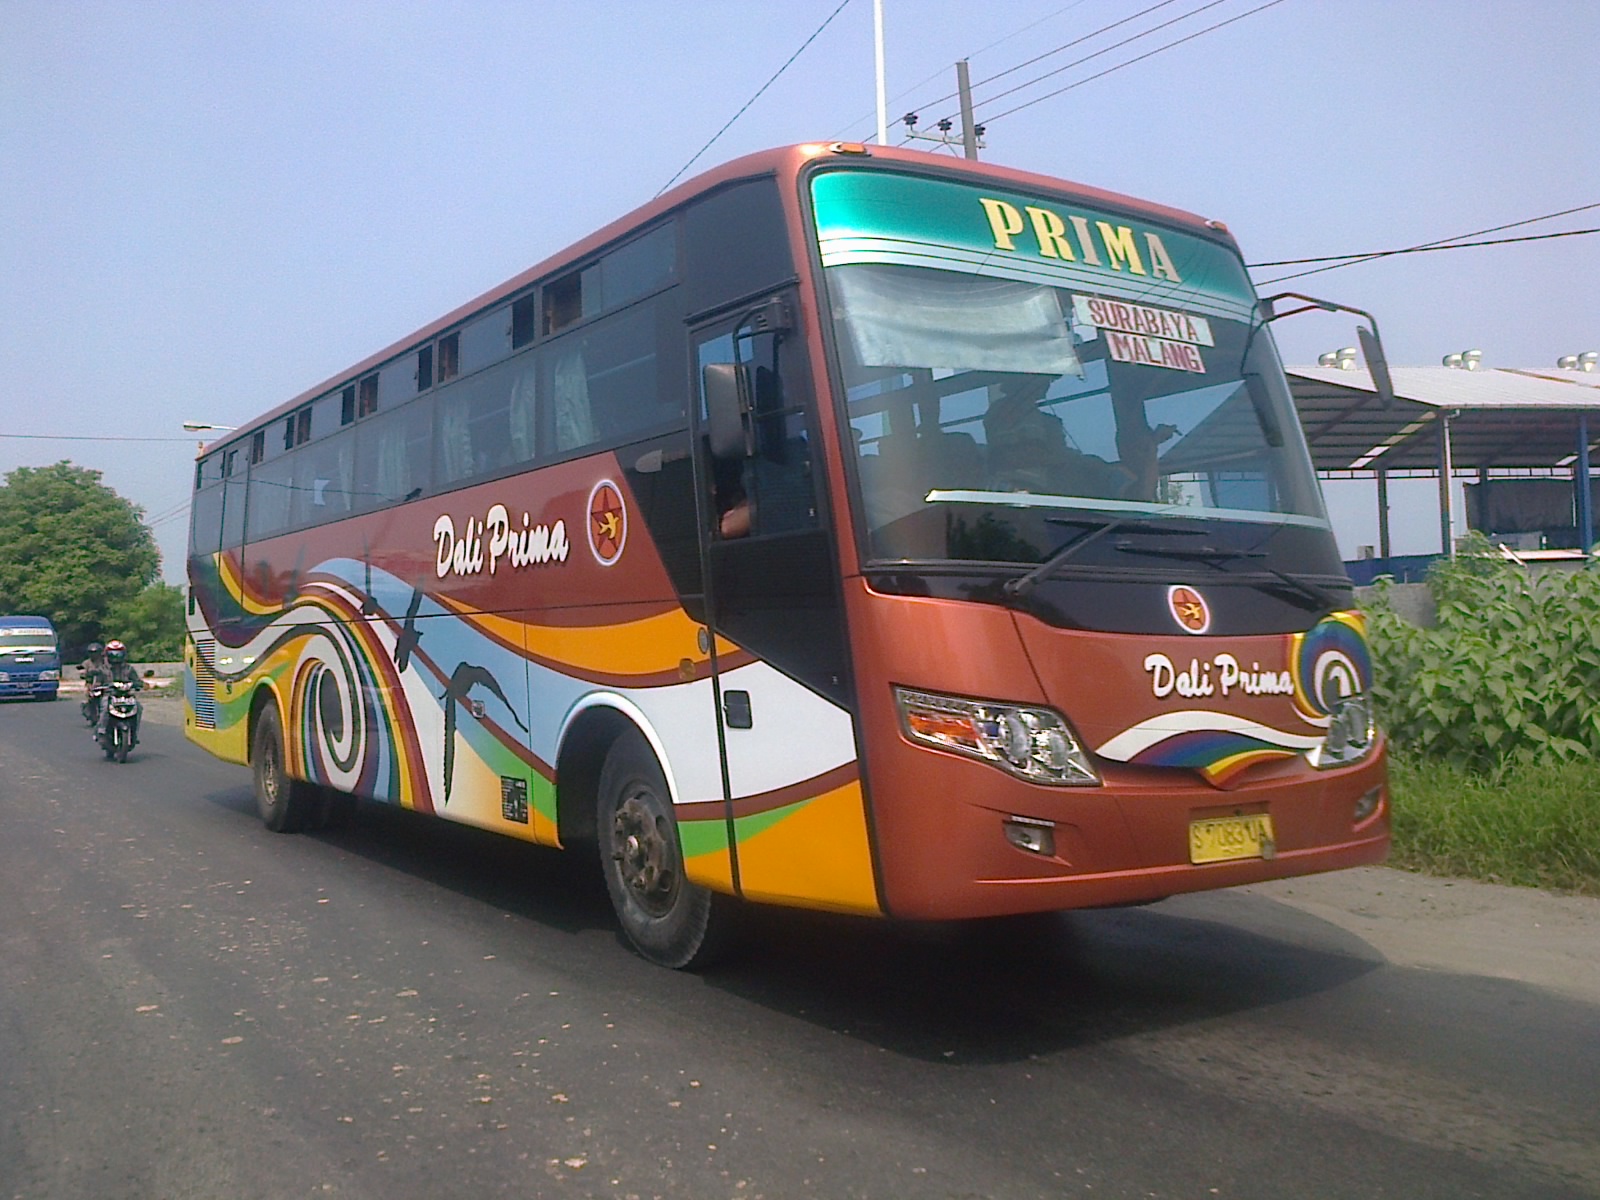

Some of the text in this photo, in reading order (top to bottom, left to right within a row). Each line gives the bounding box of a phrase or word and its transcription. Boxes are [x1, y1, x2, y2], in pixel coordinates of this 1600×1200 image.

[979, 197, 1182, 284] PRIMA
[1087, 300, 1201, 343] SURABAYA
[1111, 334, 1201, 372] MALANG
[433, 503, 569, 578] Dali Prima
[1144, 653, 1294, 697] Dali Prima
